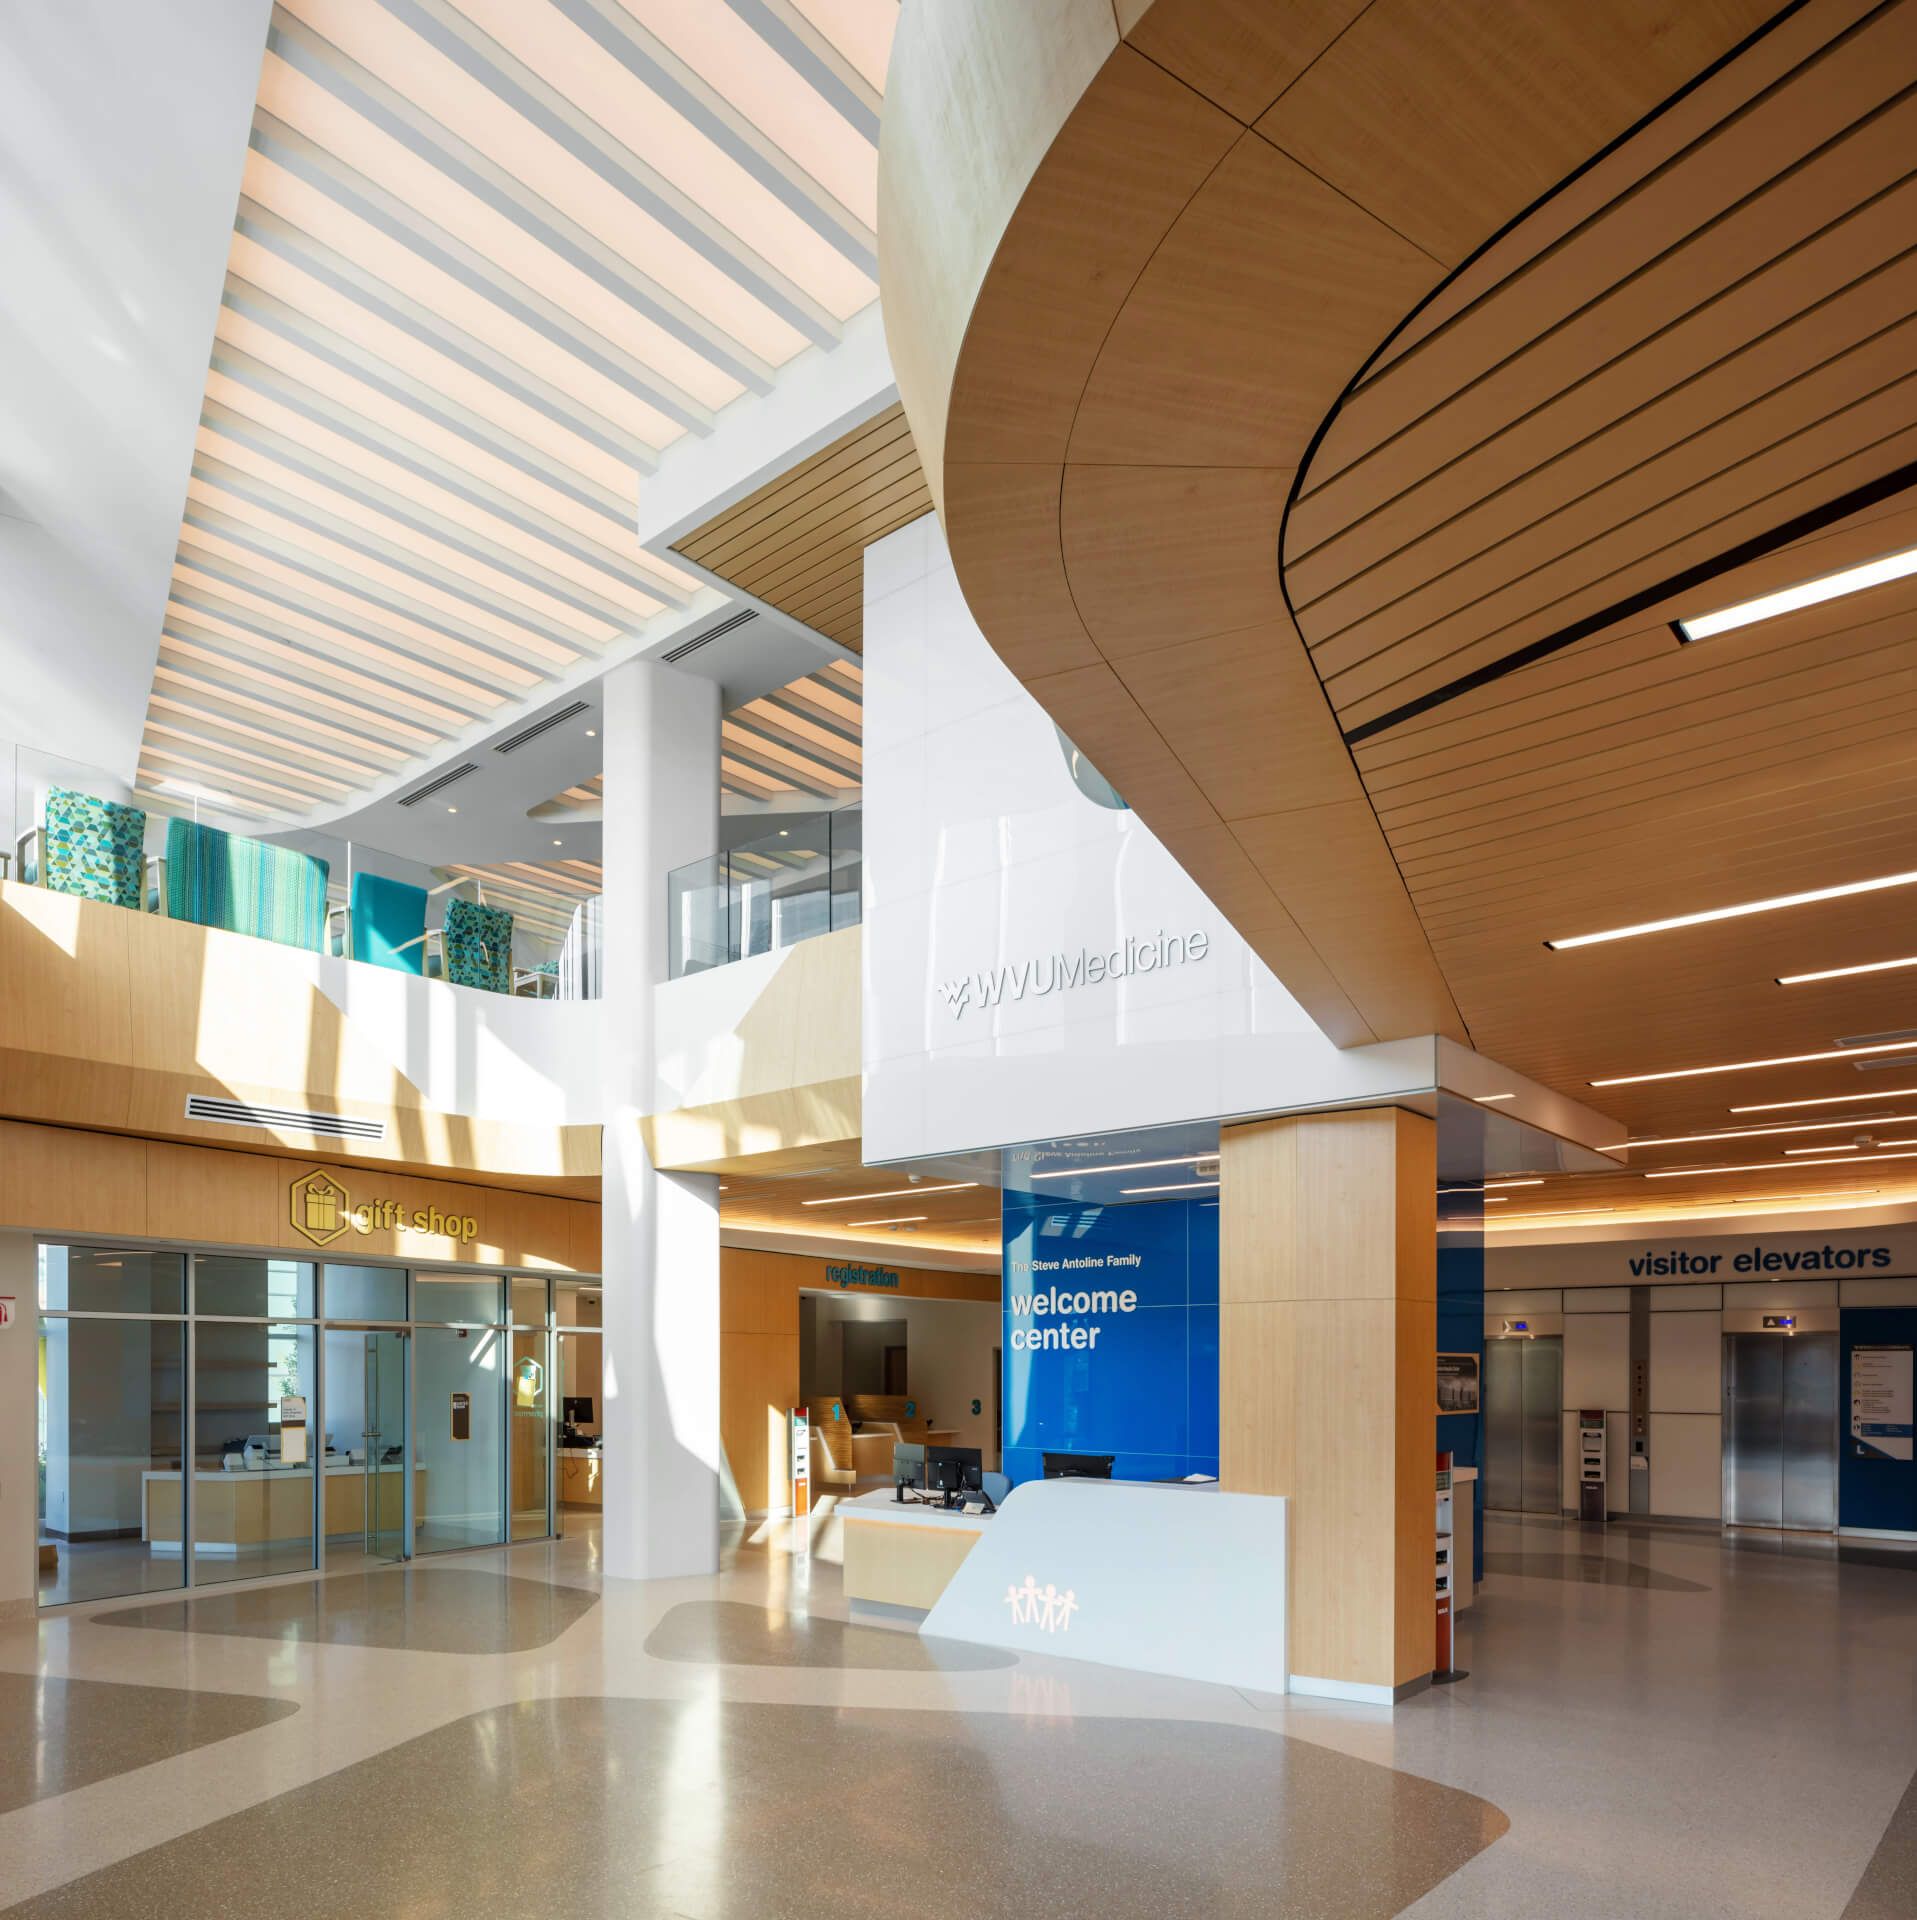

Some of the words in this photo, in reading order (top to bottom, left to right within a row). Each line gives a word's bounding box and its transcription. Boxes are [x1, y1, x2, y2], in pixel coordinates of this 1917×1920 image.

[355, 1198, 406, 1235] gift
[412, 1204, 478, 1244] shop
[1032, 1259, 1060, 1271] Steve
[1062, 1256, 1104, 1269] Antoline
[1106, 1254, 1141, 1268] Family
[1628, 1250, 1722, 1277] visitor
[1733, 1245, 1892, 1273] elevators
[826, 1263, 899, 1289] registration
[1010, 1286, 1138, 1316] welcome
[1010, 1322, 1101, 1351] center
[832, 1402, 841, 1422] 1
[905, 1401, 916, 1418] 2
[971, 1399, 982, 1415] 3
